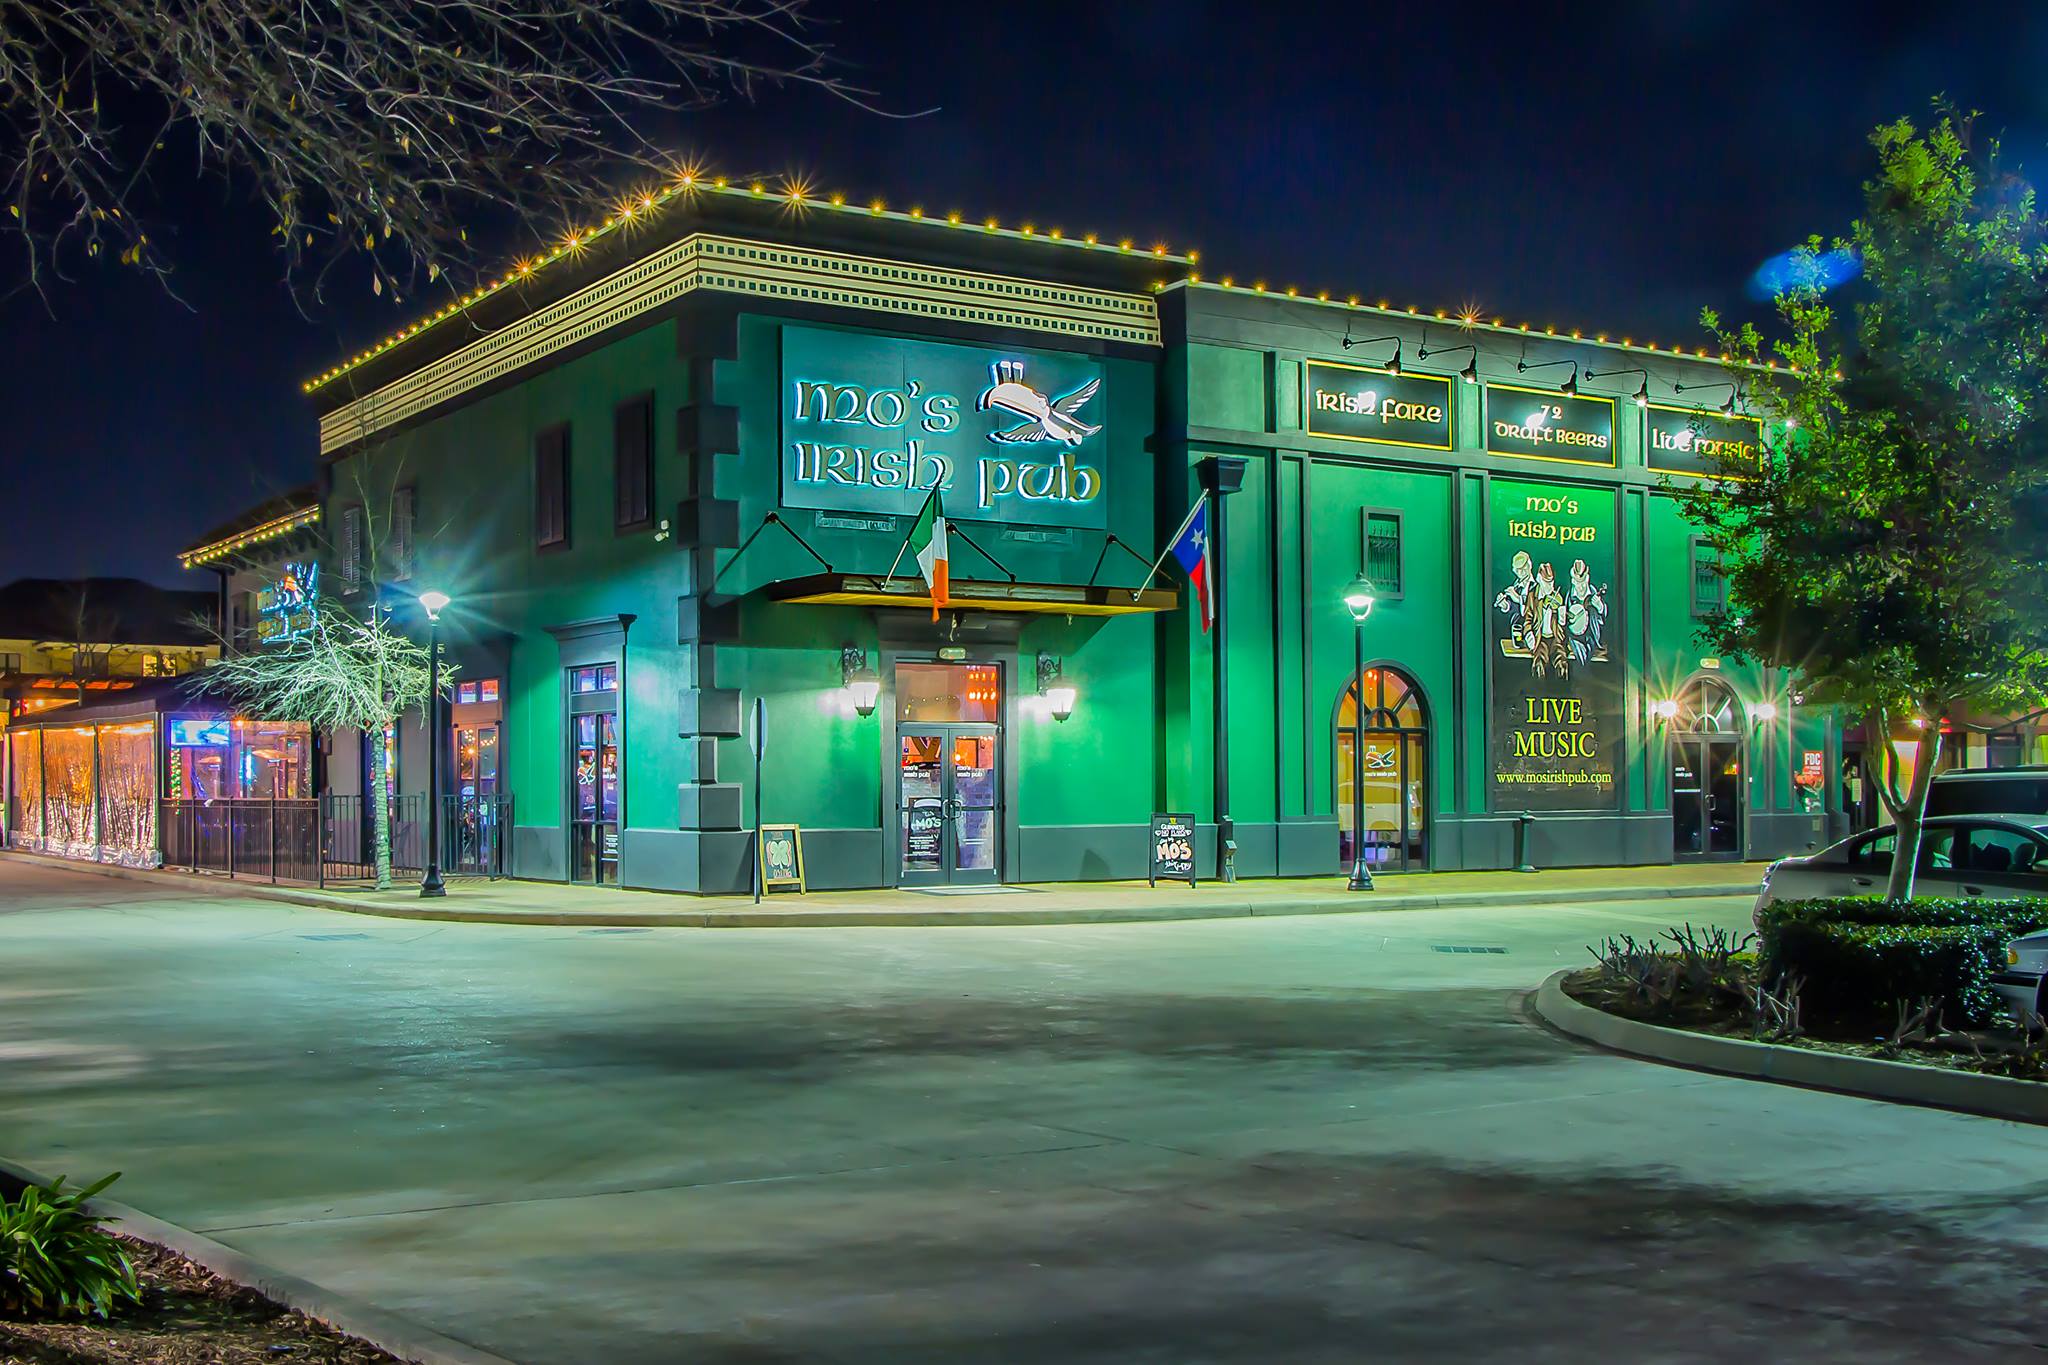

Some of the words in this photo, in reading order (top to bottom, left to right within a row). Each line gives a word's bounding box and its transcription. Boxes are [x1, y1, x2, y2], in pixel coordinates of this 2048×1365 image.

[793, 380, 960, 433] mo's
[1380, 398, 1443, 424] fare
[1493, 421, 1553, 446] draft
[1556, 429, 1608, 449] beers
[793, 439, 954, 491] irish
[977, 451, 1102, 511] pub
[1526, 495, 1579, 515] mo's
[1508, 519, 1556, 540] irish
[1559, 525, 1597, 545] pub
[1526, 697, 1583, 725] LIVE
[1513, 731, 1596, 758] MUSIC
[1496, 769, 1612, 787] www.mosirishpub.com
